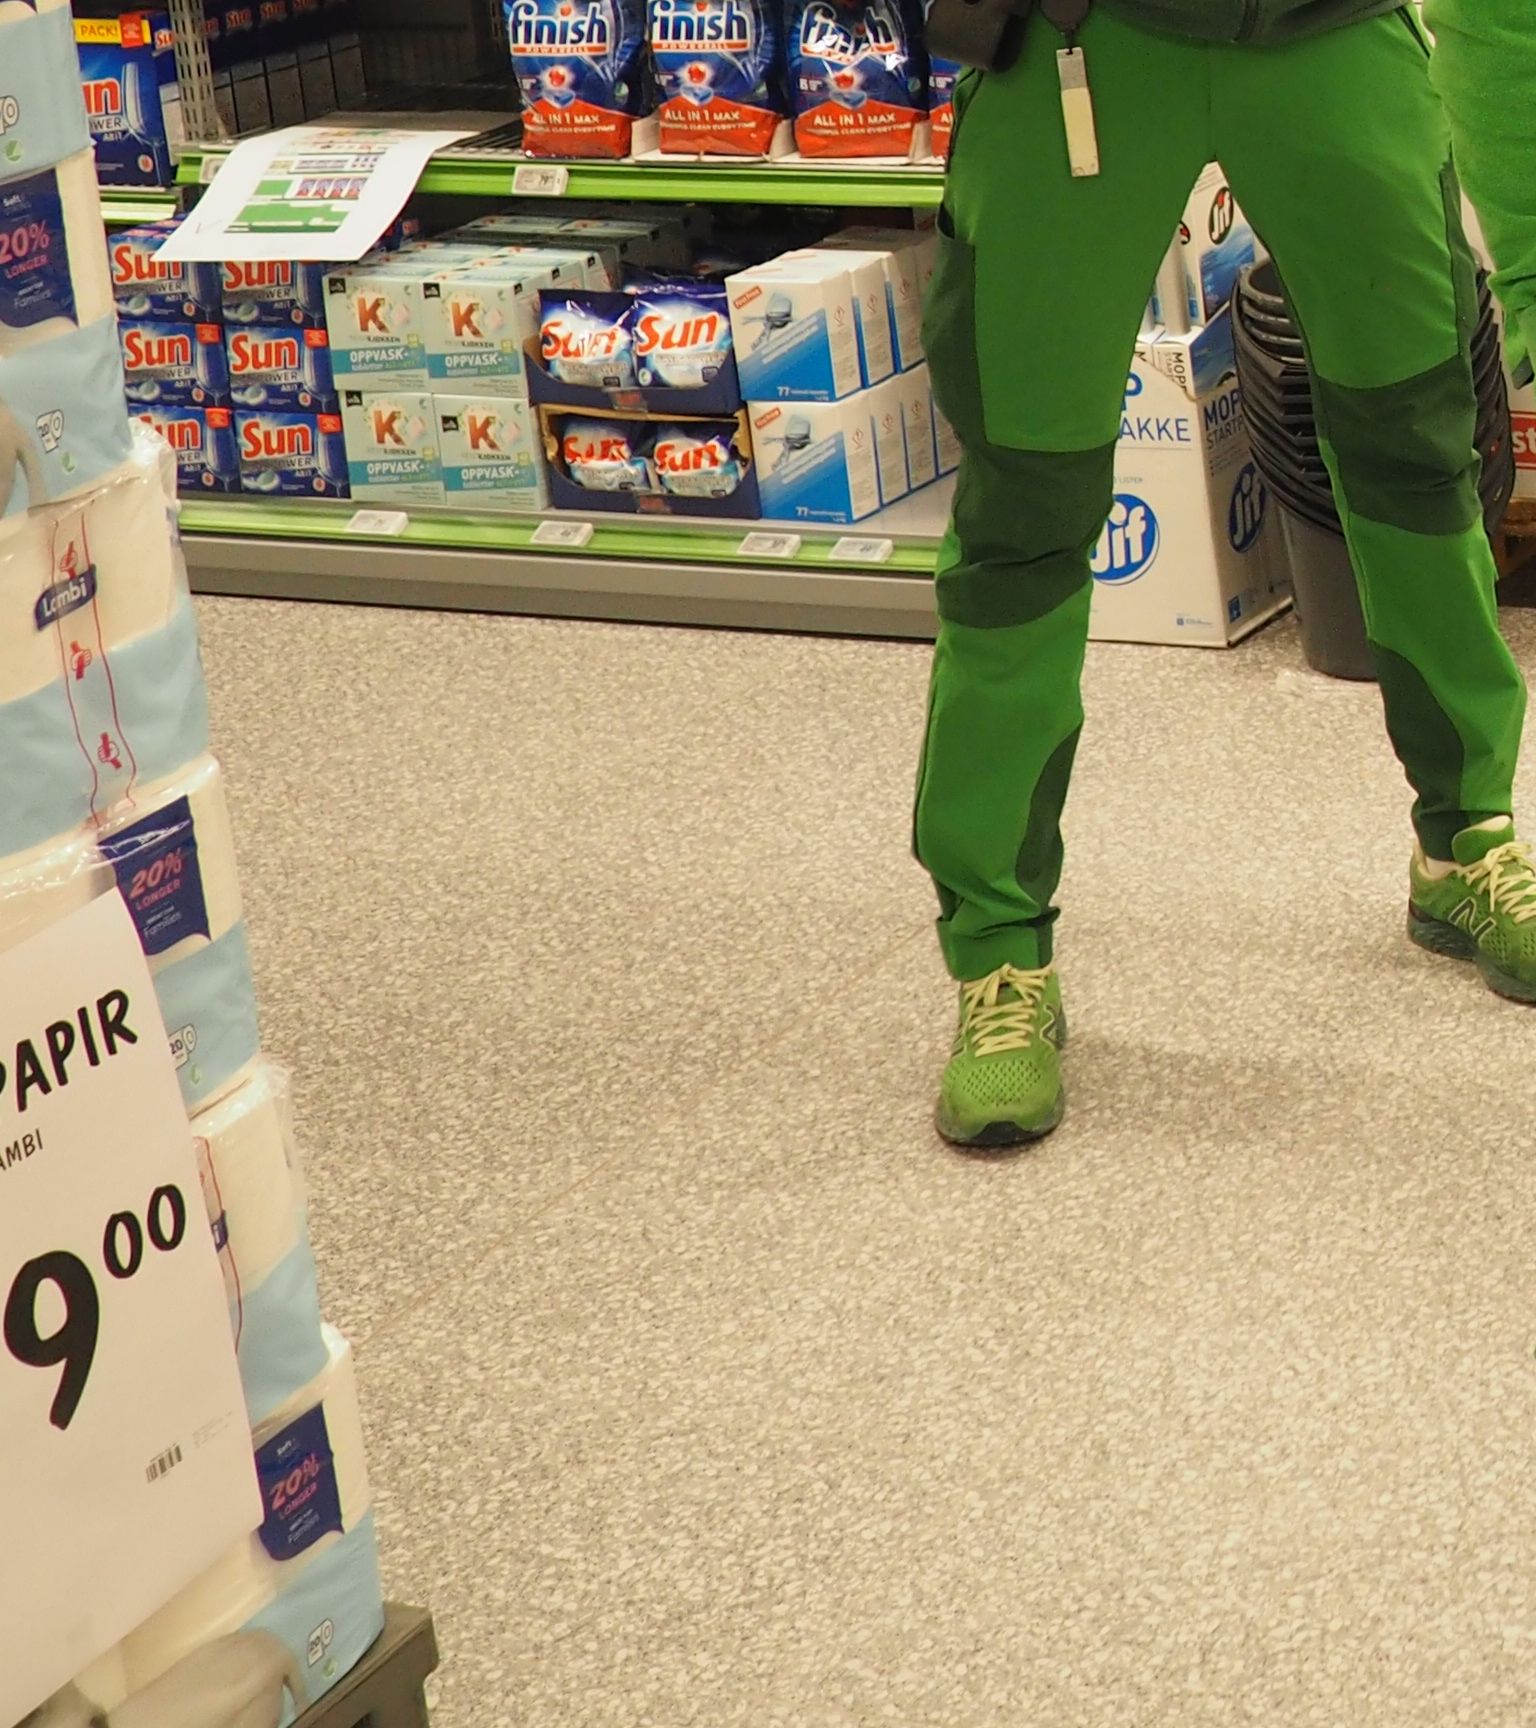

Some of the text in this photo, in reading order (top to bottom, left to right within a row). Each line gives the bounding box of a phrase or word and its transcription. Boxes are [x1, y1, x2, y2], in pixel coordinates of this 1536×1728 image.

[79, 23, 118, 37] PACK!
[124, 331, 191, 369] Sun
[635, 313, 719, 354] Sun
[230, 334, 298, 373] Sun
[242, 418, 312, 460] Sun
